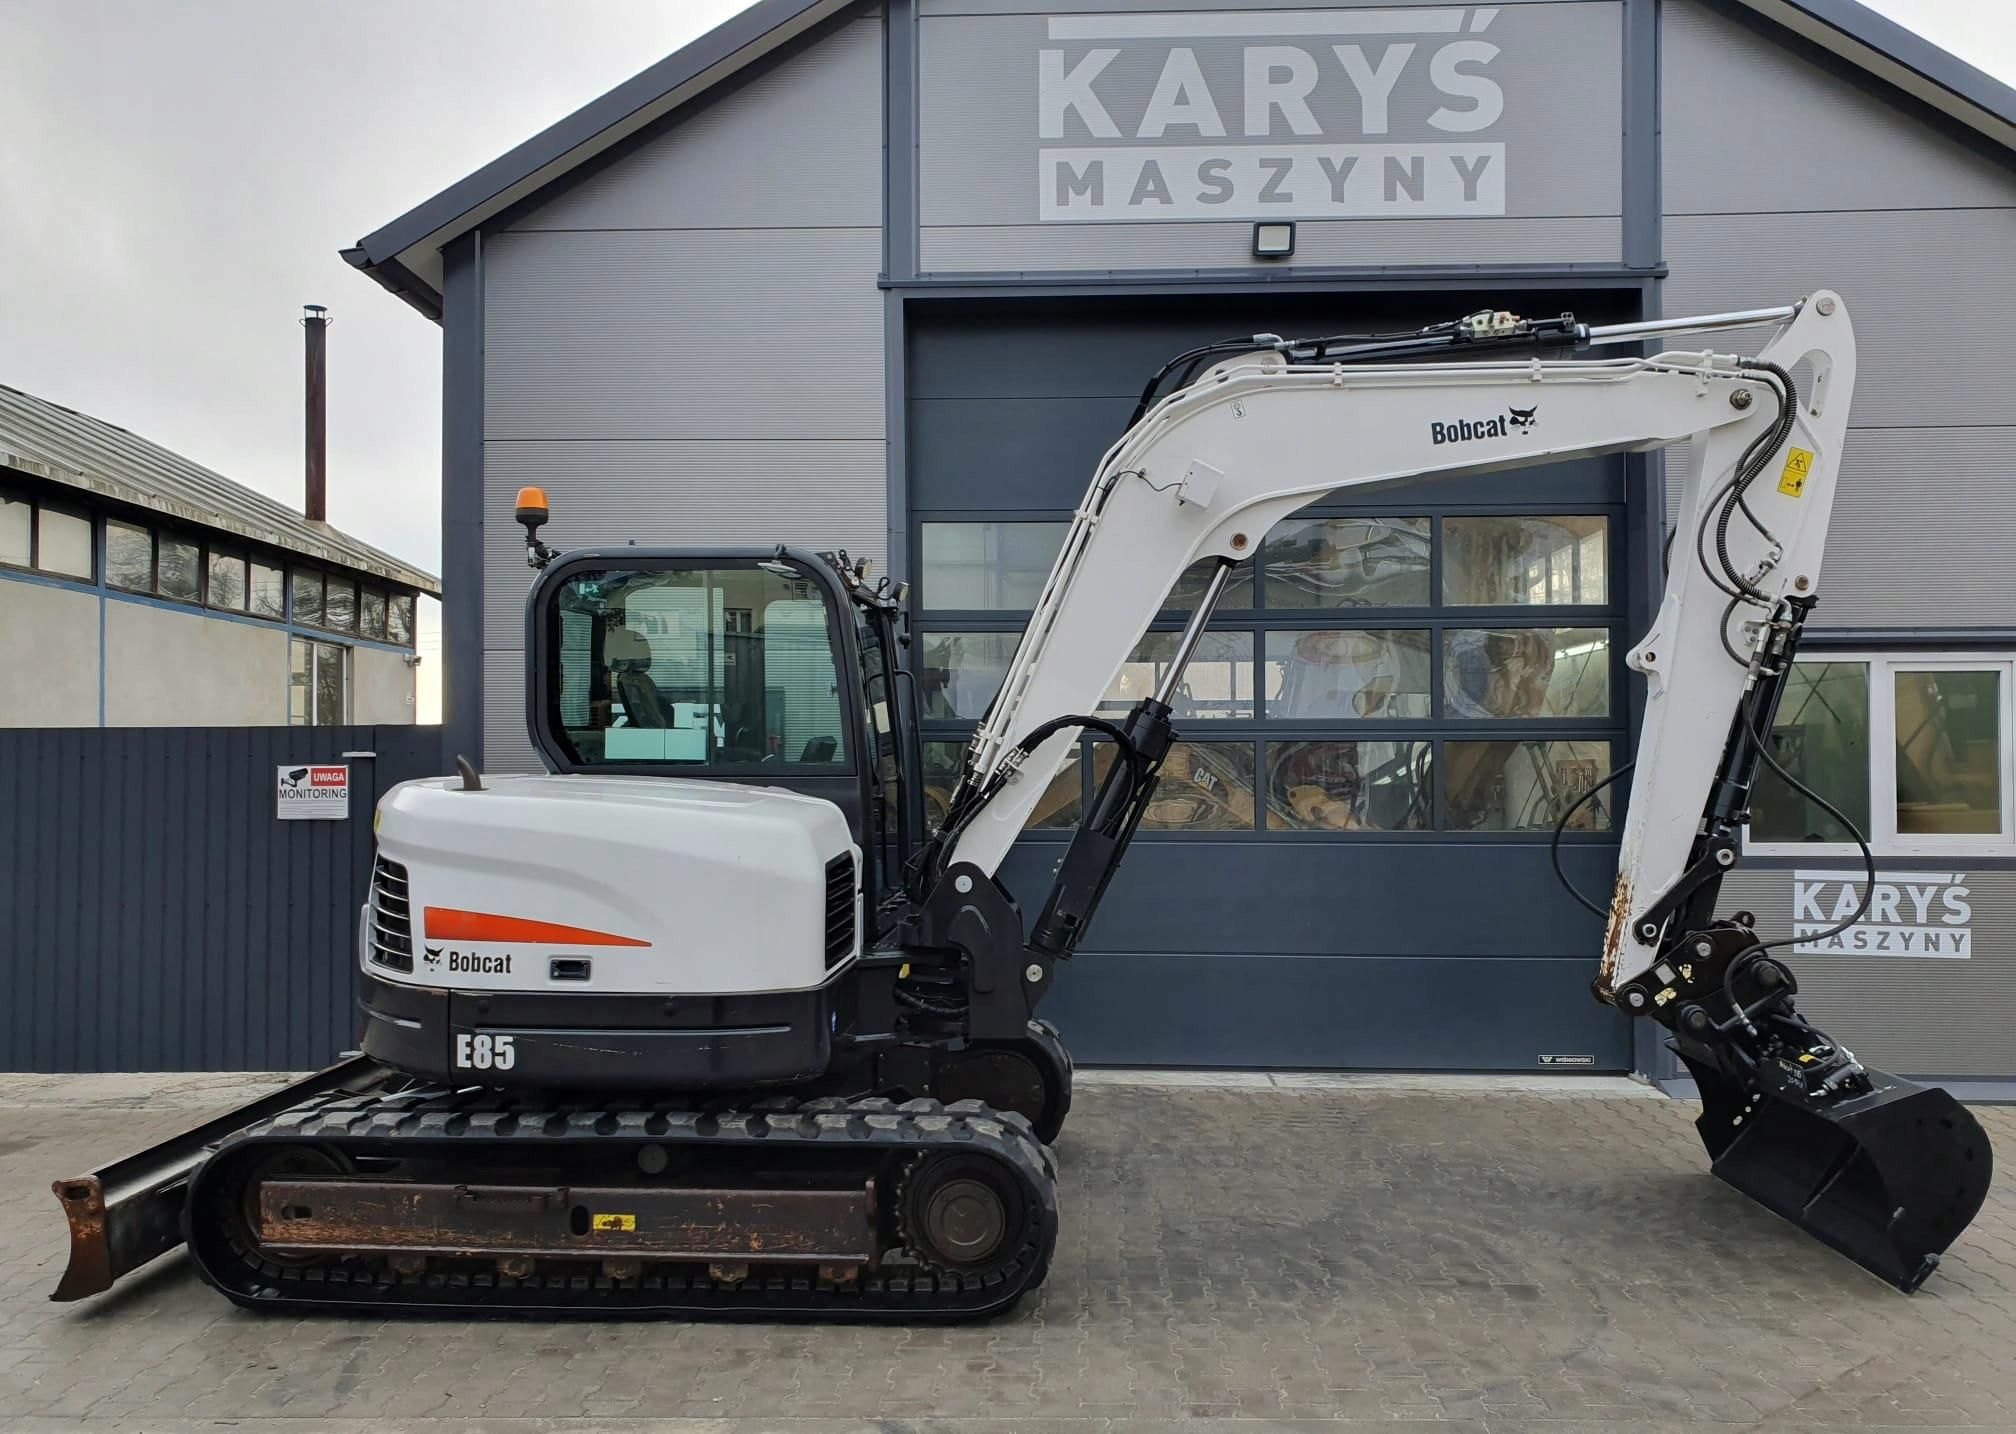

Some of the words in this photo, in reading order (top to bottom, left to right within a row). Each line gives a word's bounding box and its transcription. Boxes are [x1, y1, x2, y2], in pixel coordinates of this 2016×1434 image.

[1039, 9, 1504, 138] KARYŚ
[1056, 156, 1491, 206] MASZYNY
[1431, 415, 1507, 445] Bobcat
[313, 772, 344, 782] UWAGA
[1194, 768, 1218, 791] CAT
[279, 788, 347, 799] MONITORING
[1794, 874, 1971, 925] KARYŚ
[449, 951, 512, 974] Bobcat
[456, 1033, 515, 1070] E85
